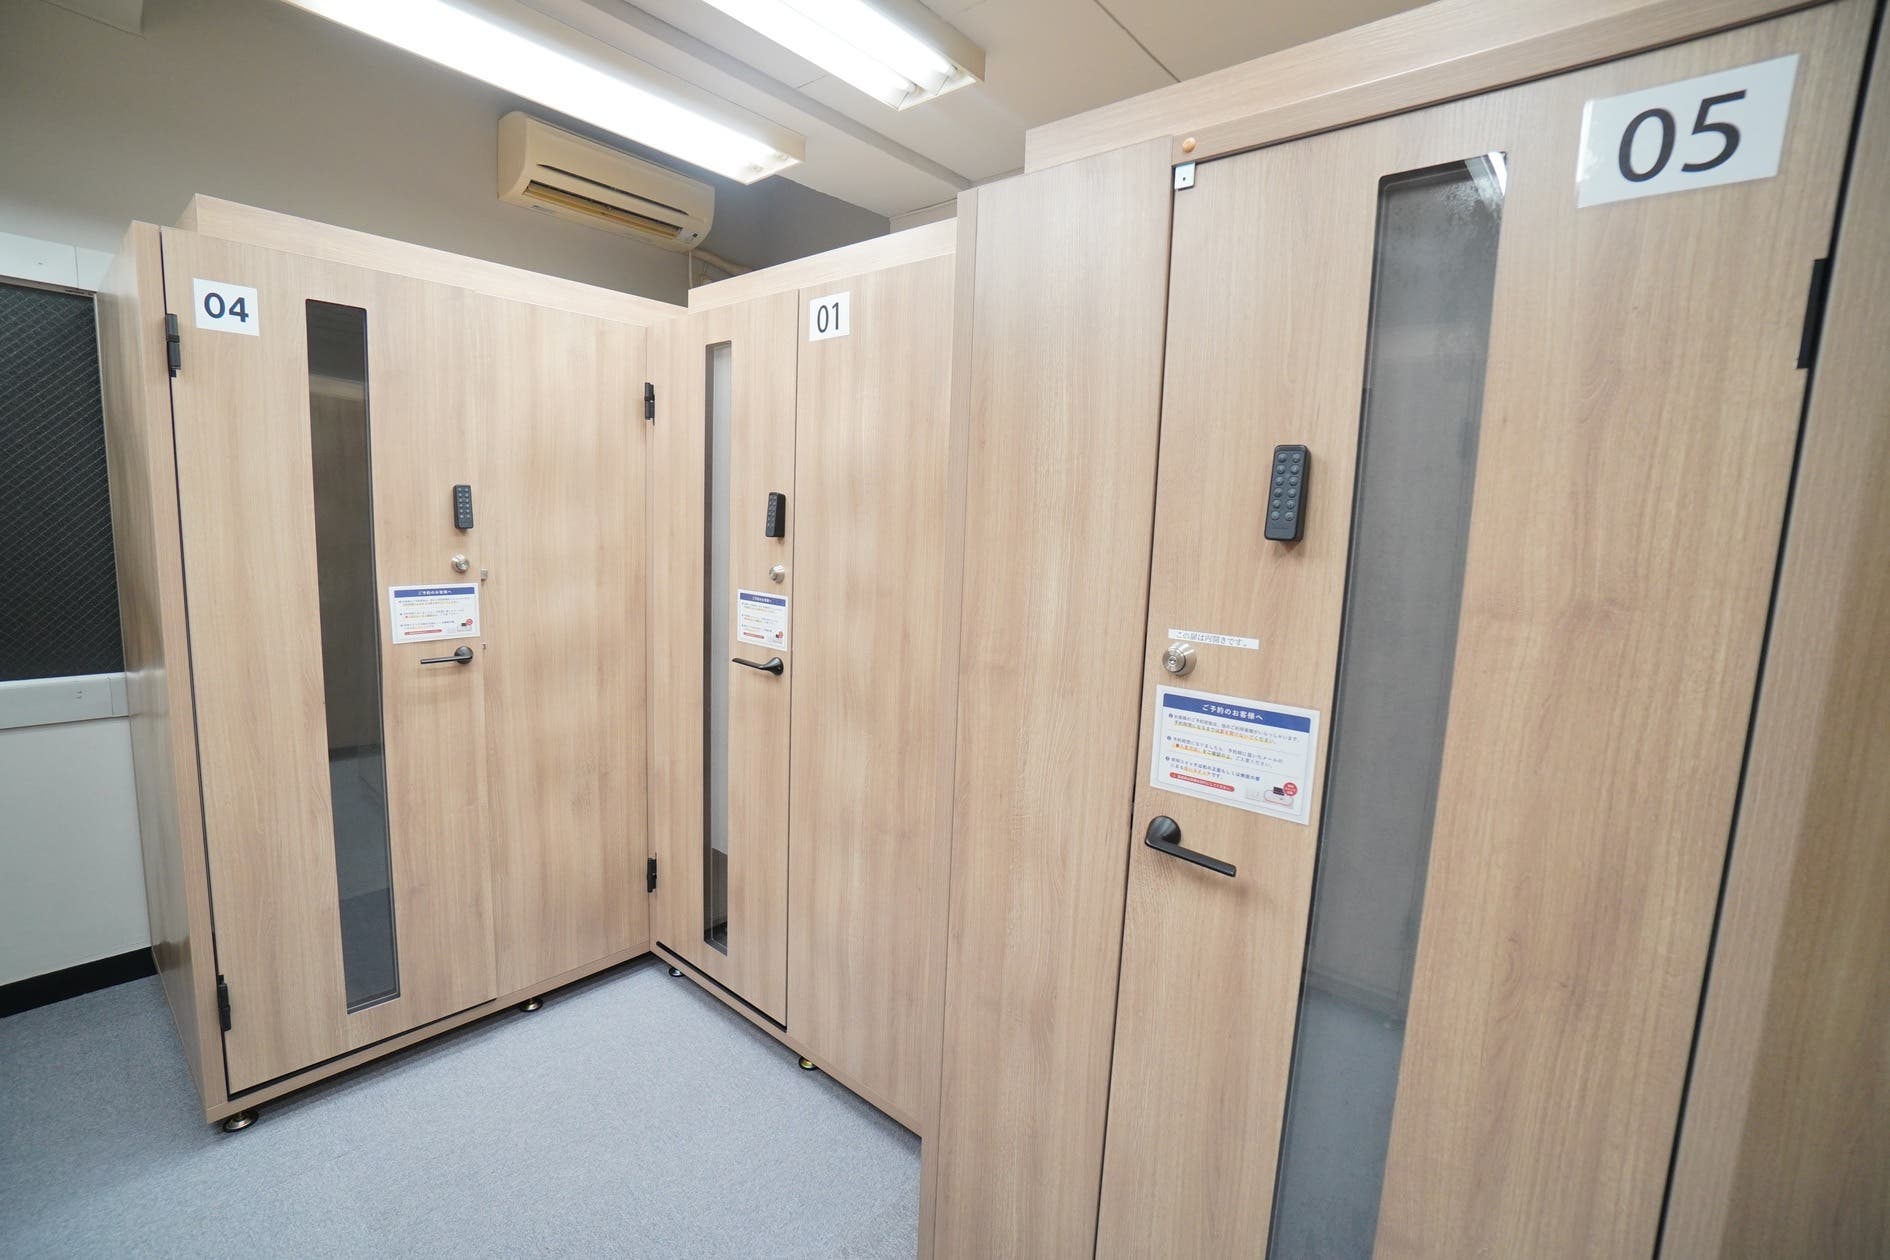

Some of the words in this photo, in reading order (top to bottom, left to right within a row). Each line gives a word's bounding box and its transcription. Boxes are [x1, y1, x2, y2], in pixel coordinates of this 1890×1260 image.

[1618, 89, 1747, 183] 05
[204, 292, 249, 323] 04
[817, 302, 839, 333] 01
[1201, 703, 1264, 721] ご予約のお客様へ
